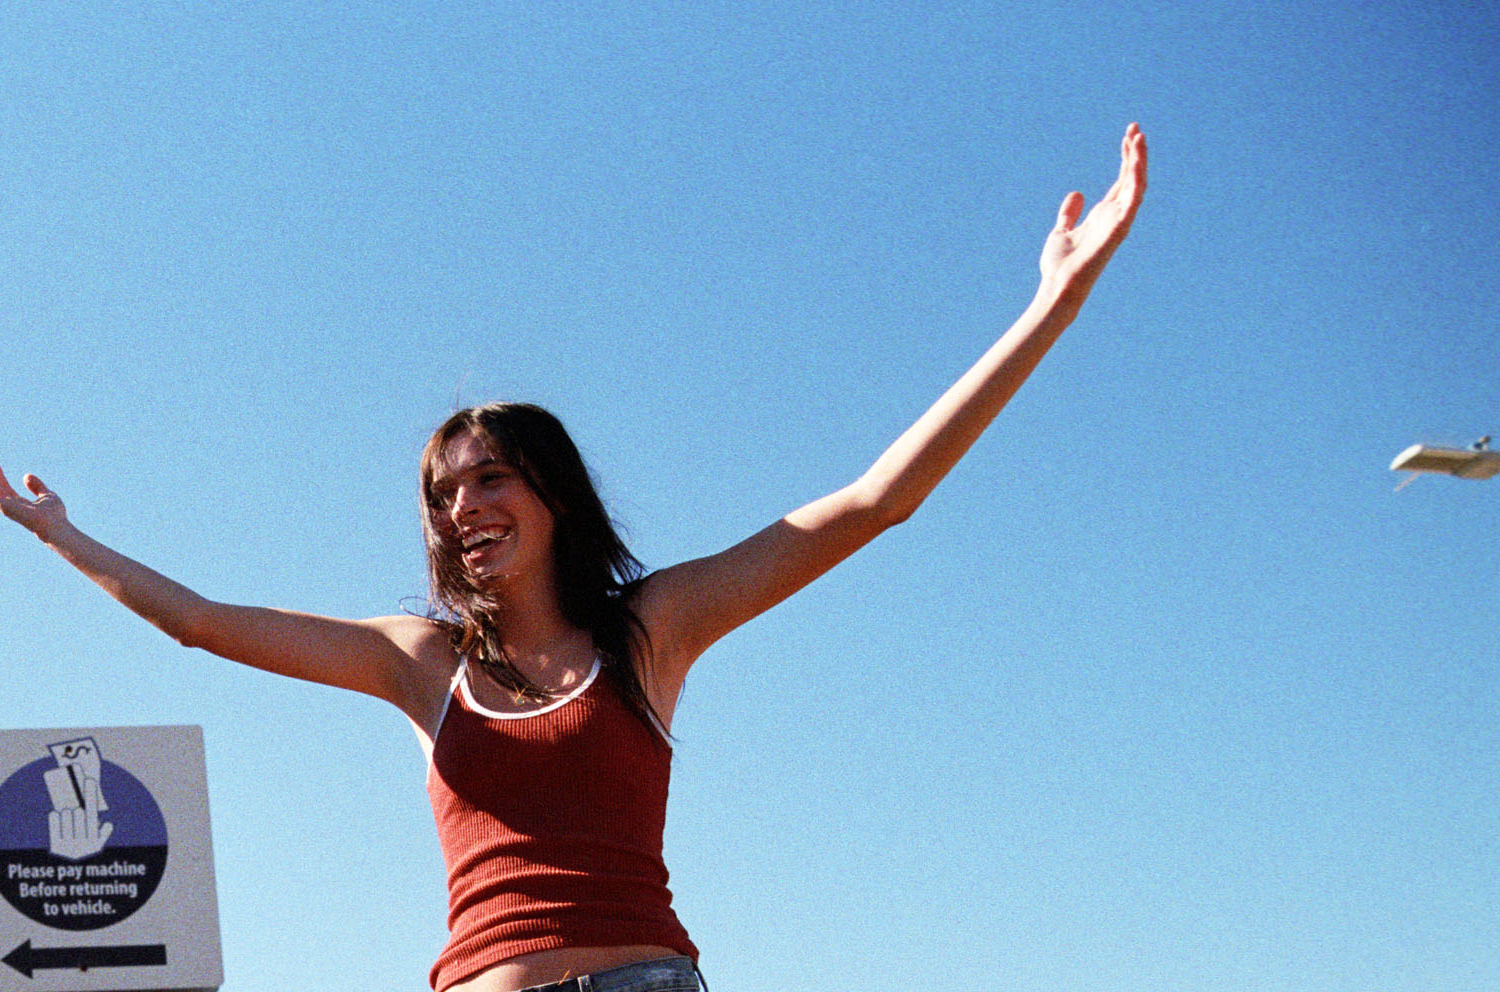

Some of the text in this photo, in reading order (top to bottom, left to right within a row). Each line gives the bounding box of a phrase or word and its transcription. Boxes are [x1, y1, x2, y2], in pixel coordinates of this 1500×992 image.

[8, 861, 146, 881] Please pay machine
[19, 879, 138, 898] Before returning
[44, 899, 116, 916] to vehicle.
